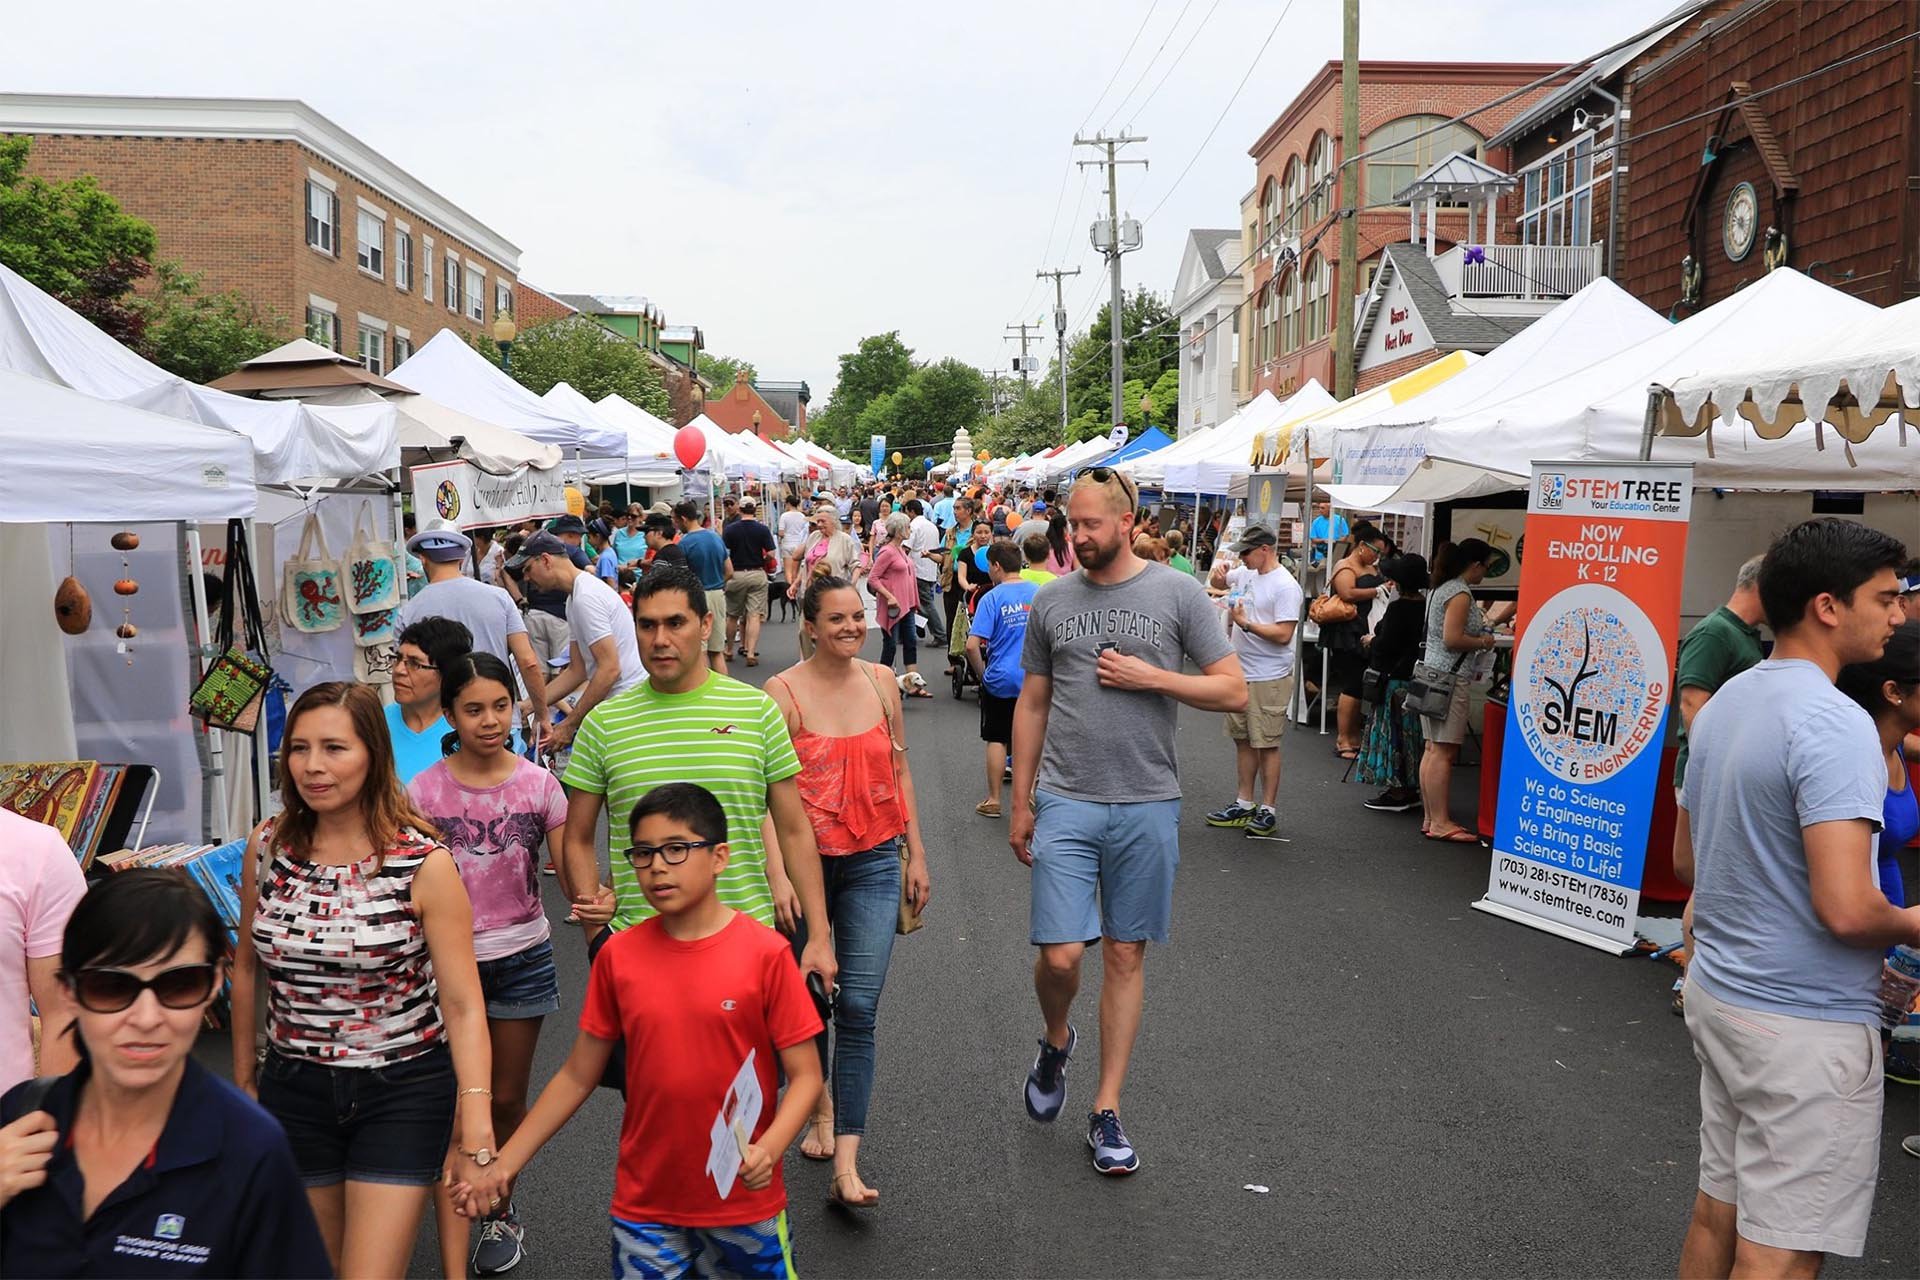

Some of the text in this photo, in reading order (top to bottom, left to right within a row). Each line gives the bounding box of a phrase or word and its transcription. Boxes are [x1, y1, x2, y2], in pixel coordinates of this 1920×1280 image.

[1591, 501, 1680, 513] Your Education Center
[1548, 540, 1659, 567] ENROLLING
[1581, 524, 1624, 542] NOW
[1055, 608, 1162, 650] PENN STATE
[1520, 682, 1664, 779] SCIENCE & ENGINEERING
[1543, 701, 1618, 746] STEM
[1521, 796, 1532, 813] &
[1525, 777, 1626, 816] We do Science
[1514, 835, 1623, 880] Science to Life!
[1519, 816, 1624, 859] We Bring Basic
[1499, 858, 1629, 909] (703) 281-STEM (7836)
[1499, 878, 1626, 929] www.stemtree.com
